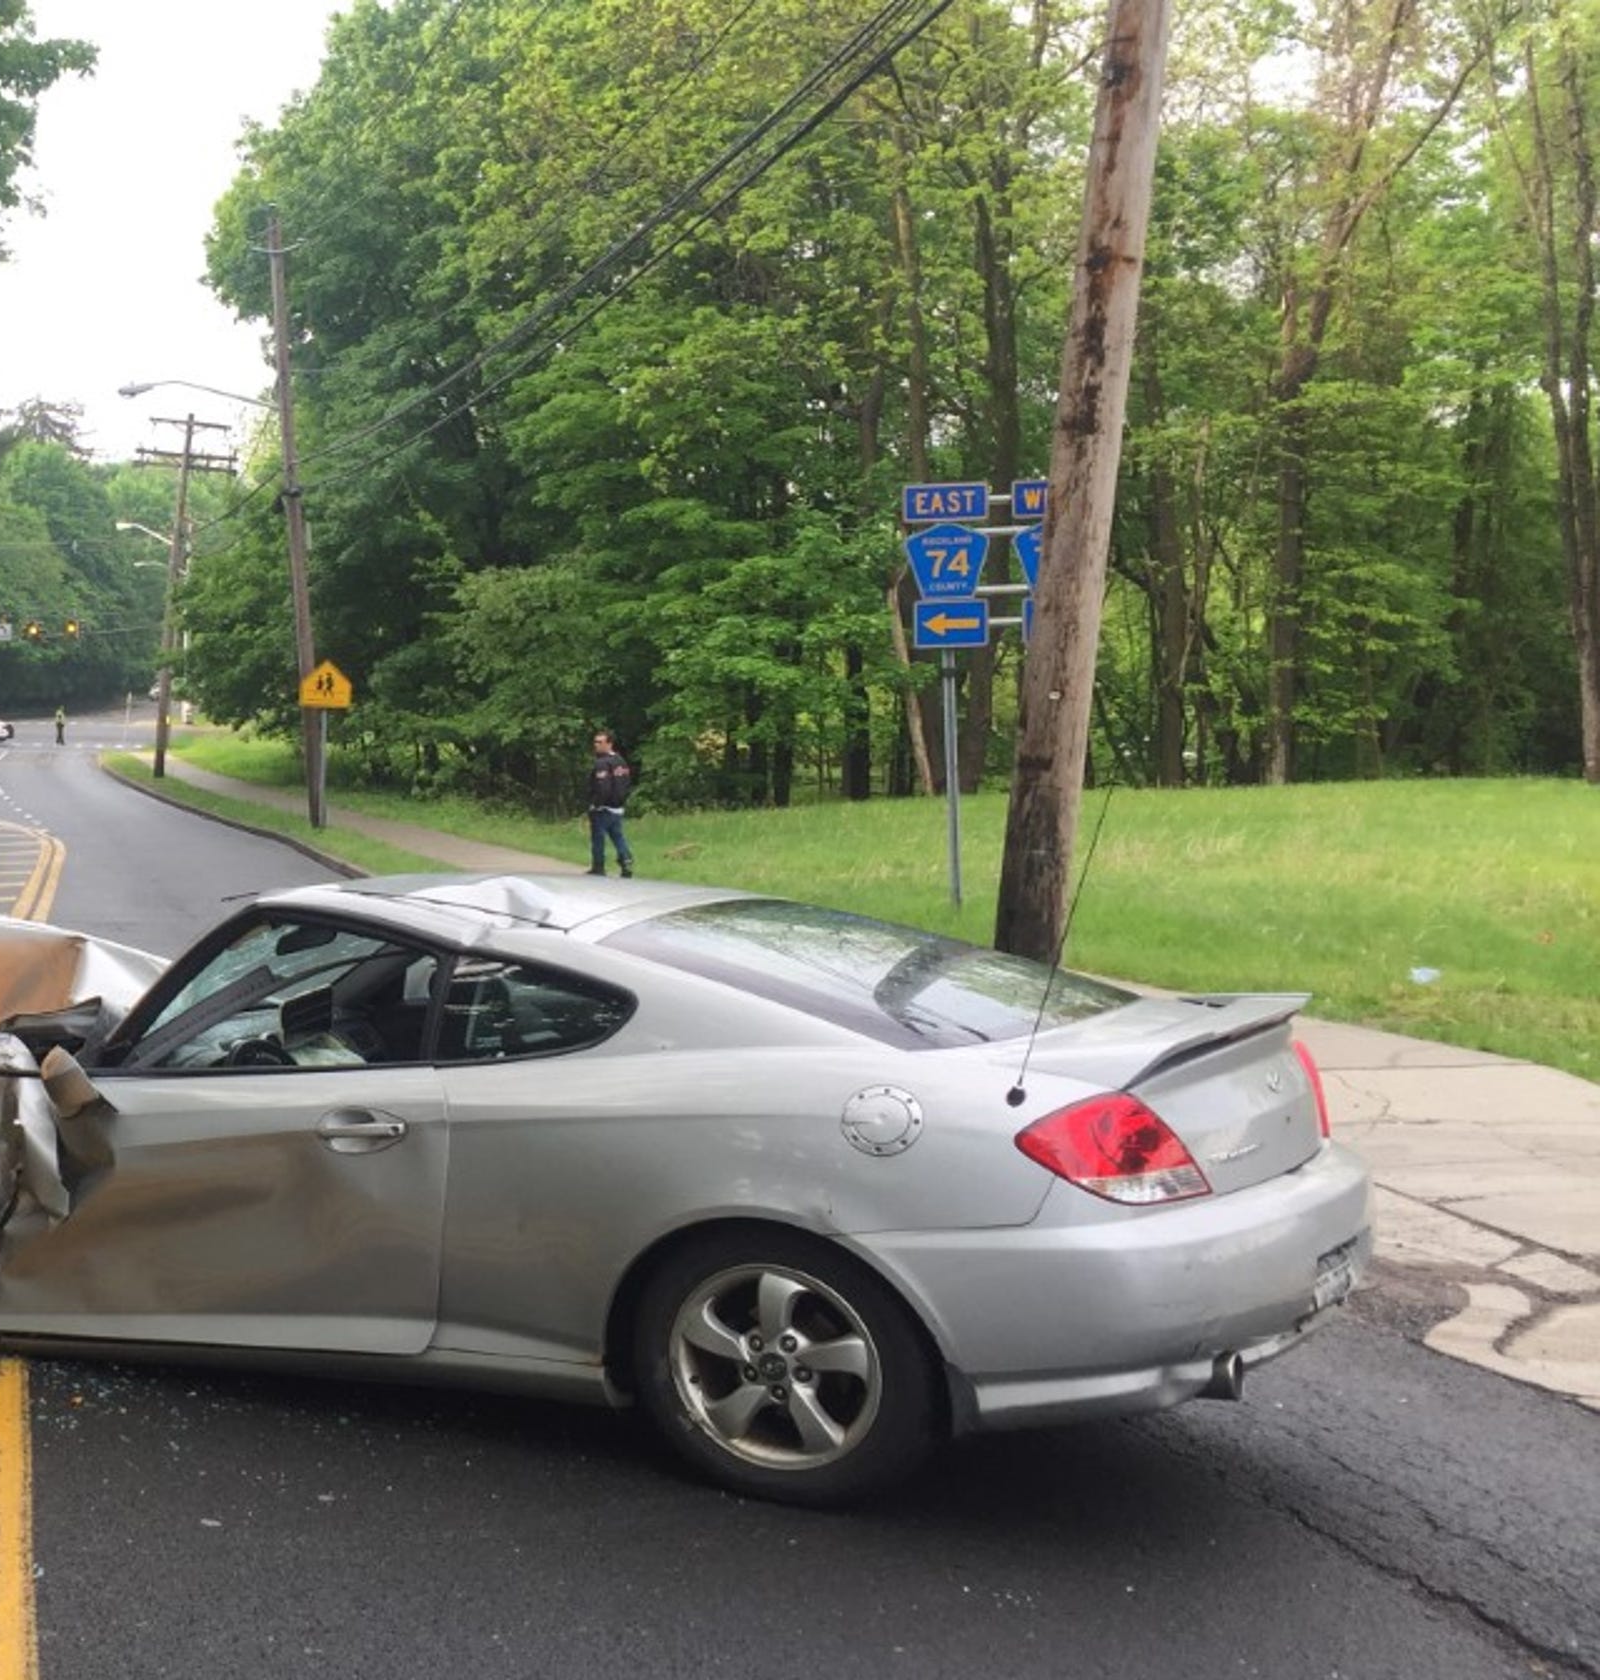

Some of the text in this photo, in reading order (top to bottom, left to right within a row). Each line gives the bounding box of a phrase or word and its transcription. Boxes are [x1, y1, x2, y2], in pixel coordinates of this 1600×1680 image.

[915, 491, 976, 515] EAST
[925, 549, 970, 578] 74
[929, 581, 969, 592] COUNTY
